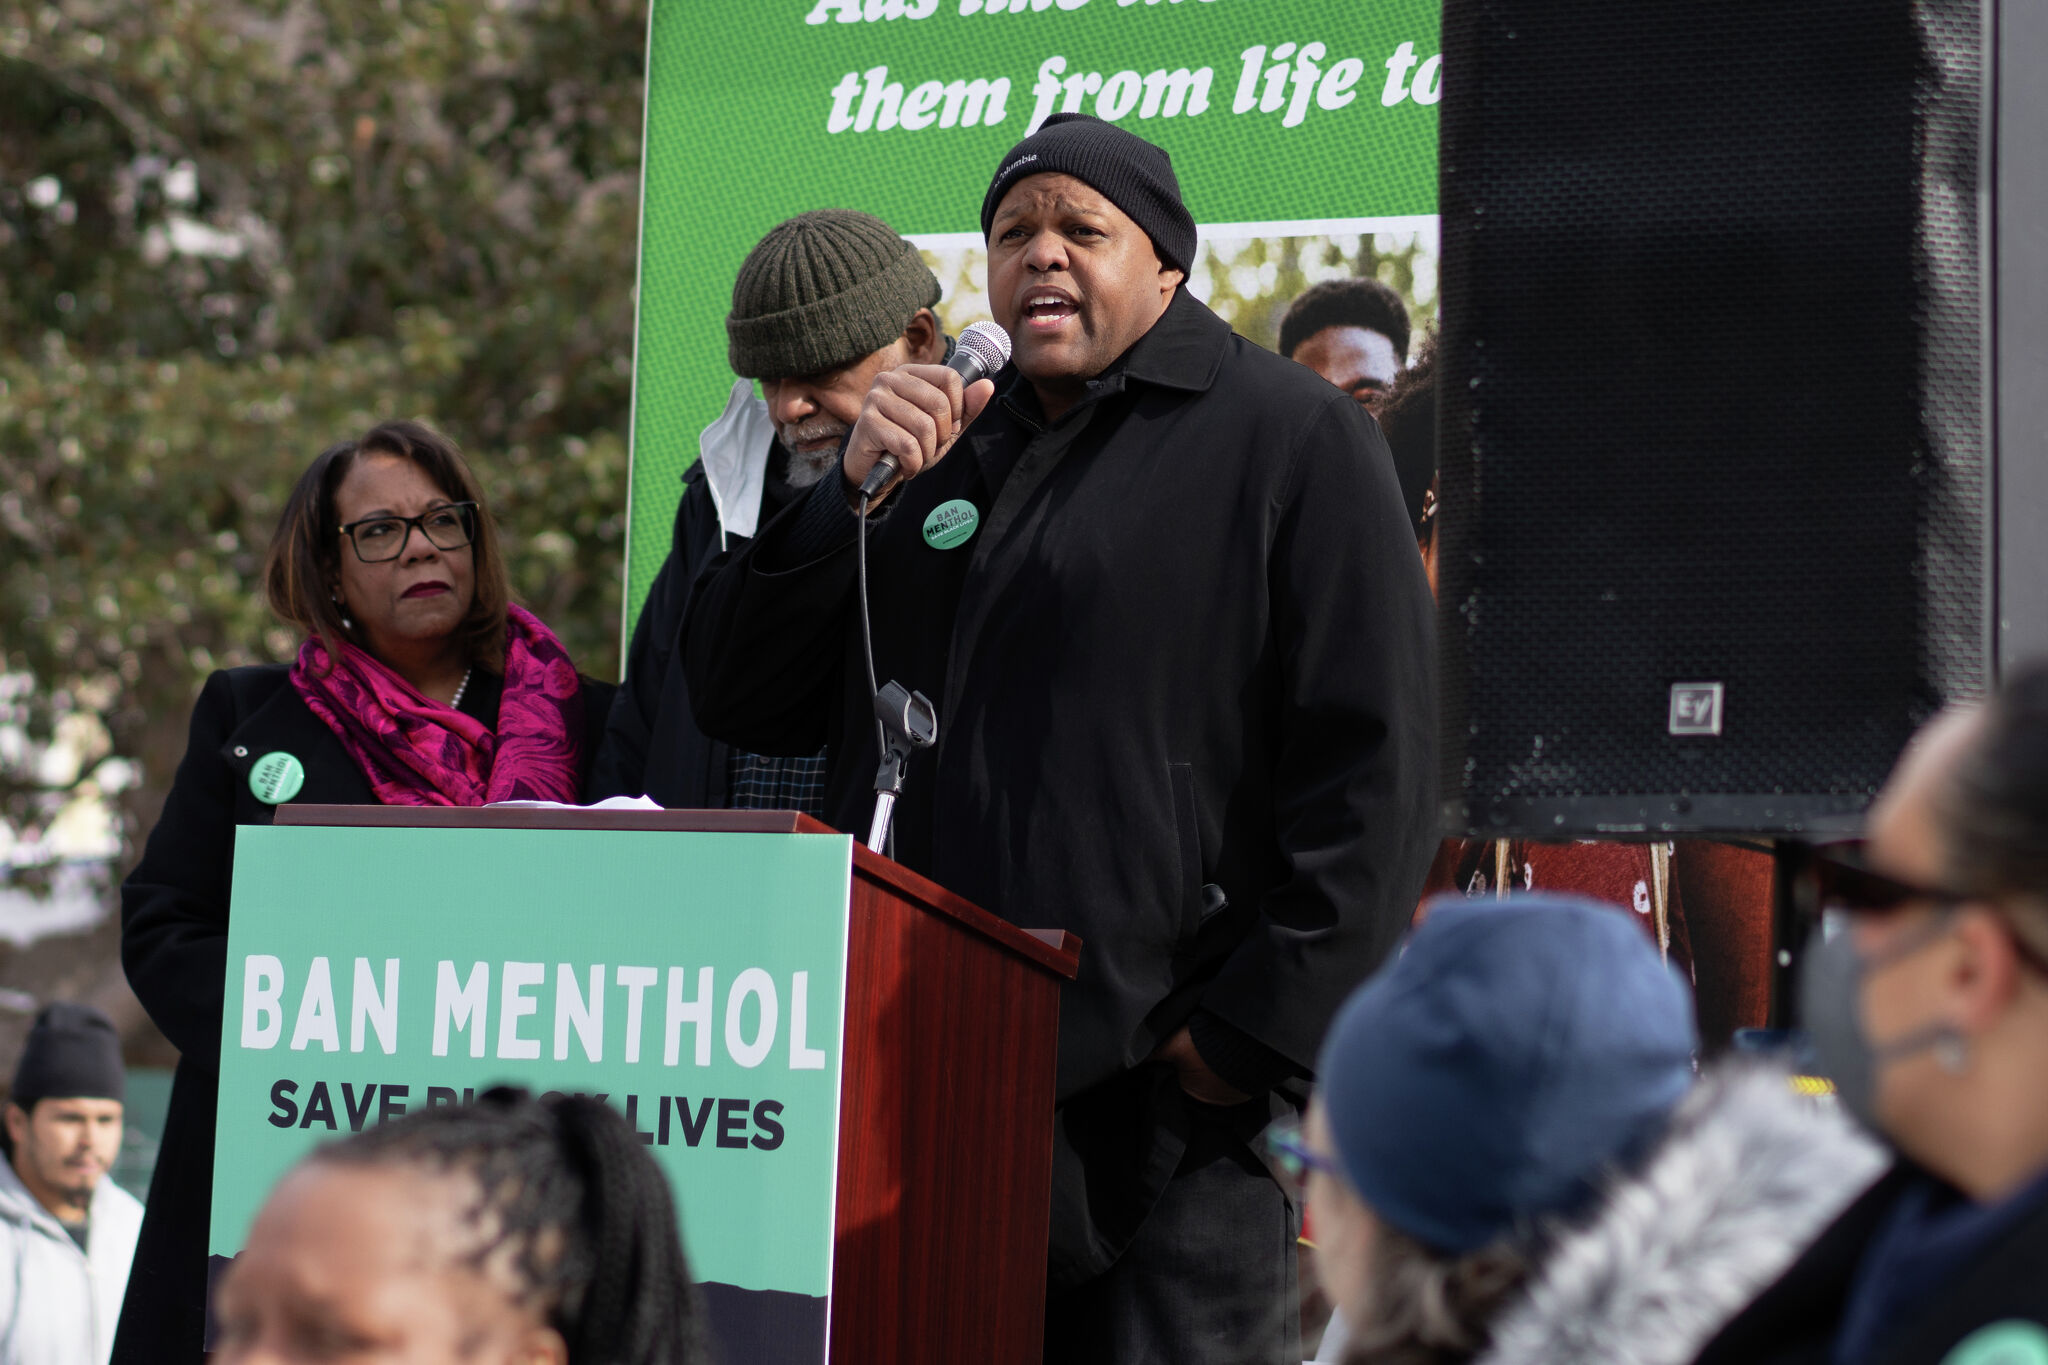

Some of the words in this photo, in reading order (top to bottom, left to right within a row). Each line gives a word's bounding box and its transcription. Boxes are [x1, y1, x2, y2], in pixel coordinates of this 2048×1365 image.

[827, 66, 1011, 134] them
[1024, 55, 1214, 138] from
[1231, 41, 1364, 127] life
[926, 510, 975, 537] MENTHOL
[936, 506, 959, 522] BAN
[240, 954, 400, 1055] BAN
[432, 960, 826, 1070] MENTHOL
[268, 1079, 409, 1132] SAVE
[626, 1095, 785, 1151] LIVES
